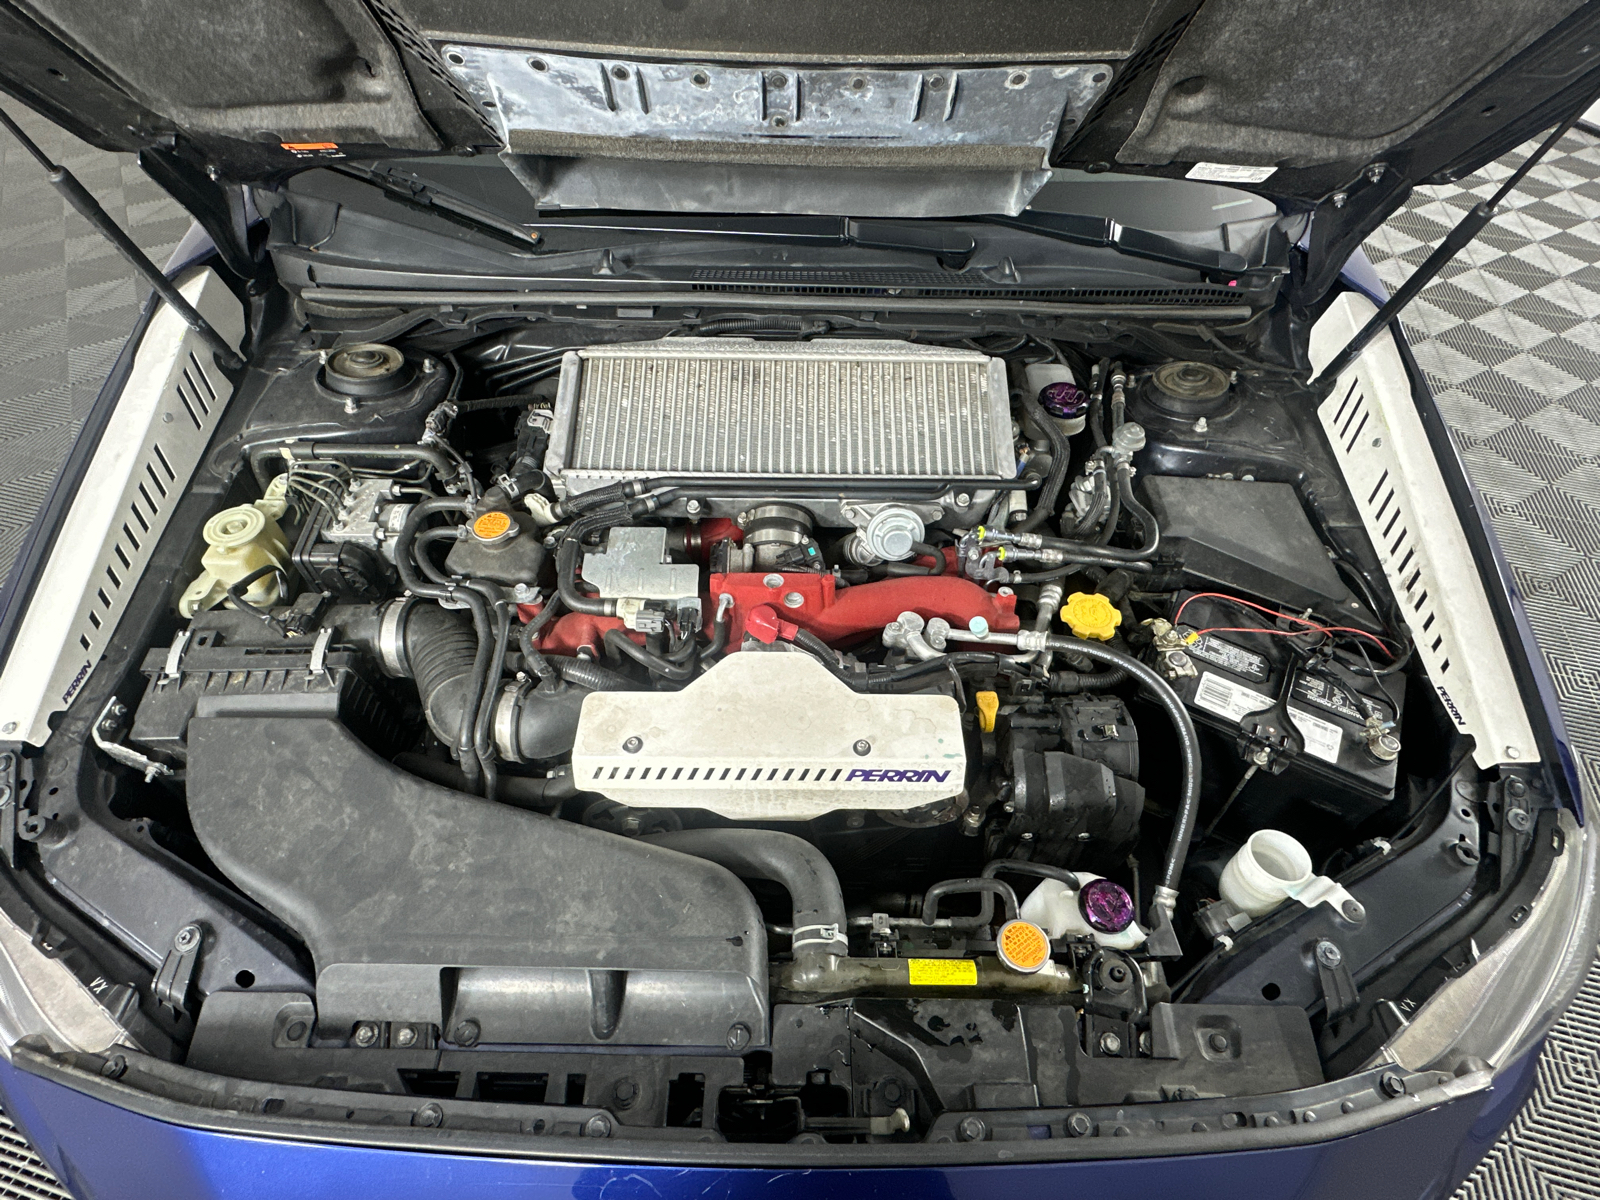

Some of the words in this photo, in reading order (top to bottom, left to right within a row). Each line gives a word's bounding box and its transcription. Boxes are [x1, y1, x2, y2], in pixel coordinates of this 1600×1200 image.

[62, 659, 92, 704] PERRIN
[1436, 686, 1466, 725] PERRIN
[844, 768, 953, 783] PERRIN
